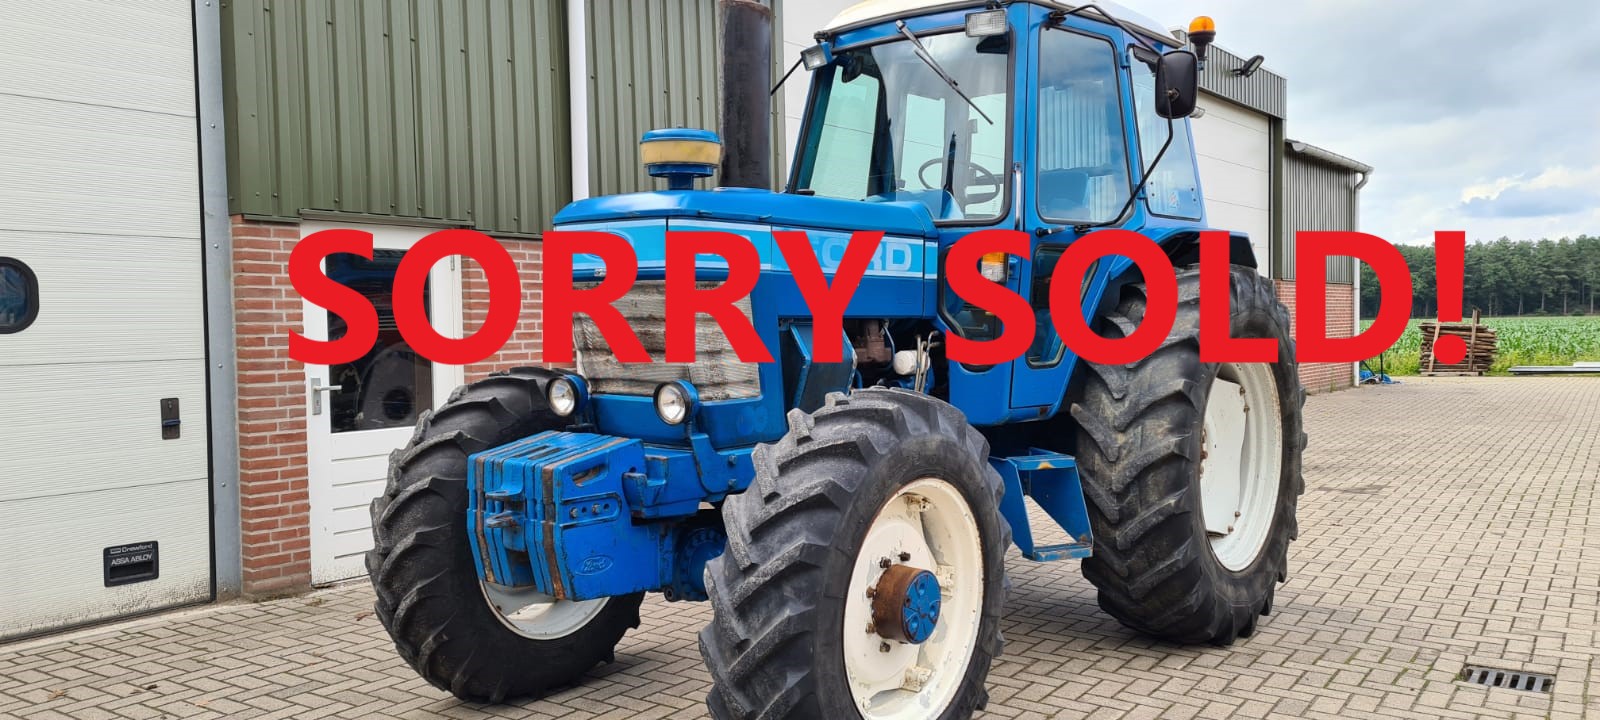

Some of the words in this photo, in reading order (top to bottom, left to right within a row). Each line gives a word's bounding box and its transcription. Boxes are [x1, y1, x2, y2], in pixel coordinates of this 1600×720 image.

[799, 237, 912, 271] OD
[111, 557, 130, 566] ASSA
[131, 553, 153, 562] ABLOY
